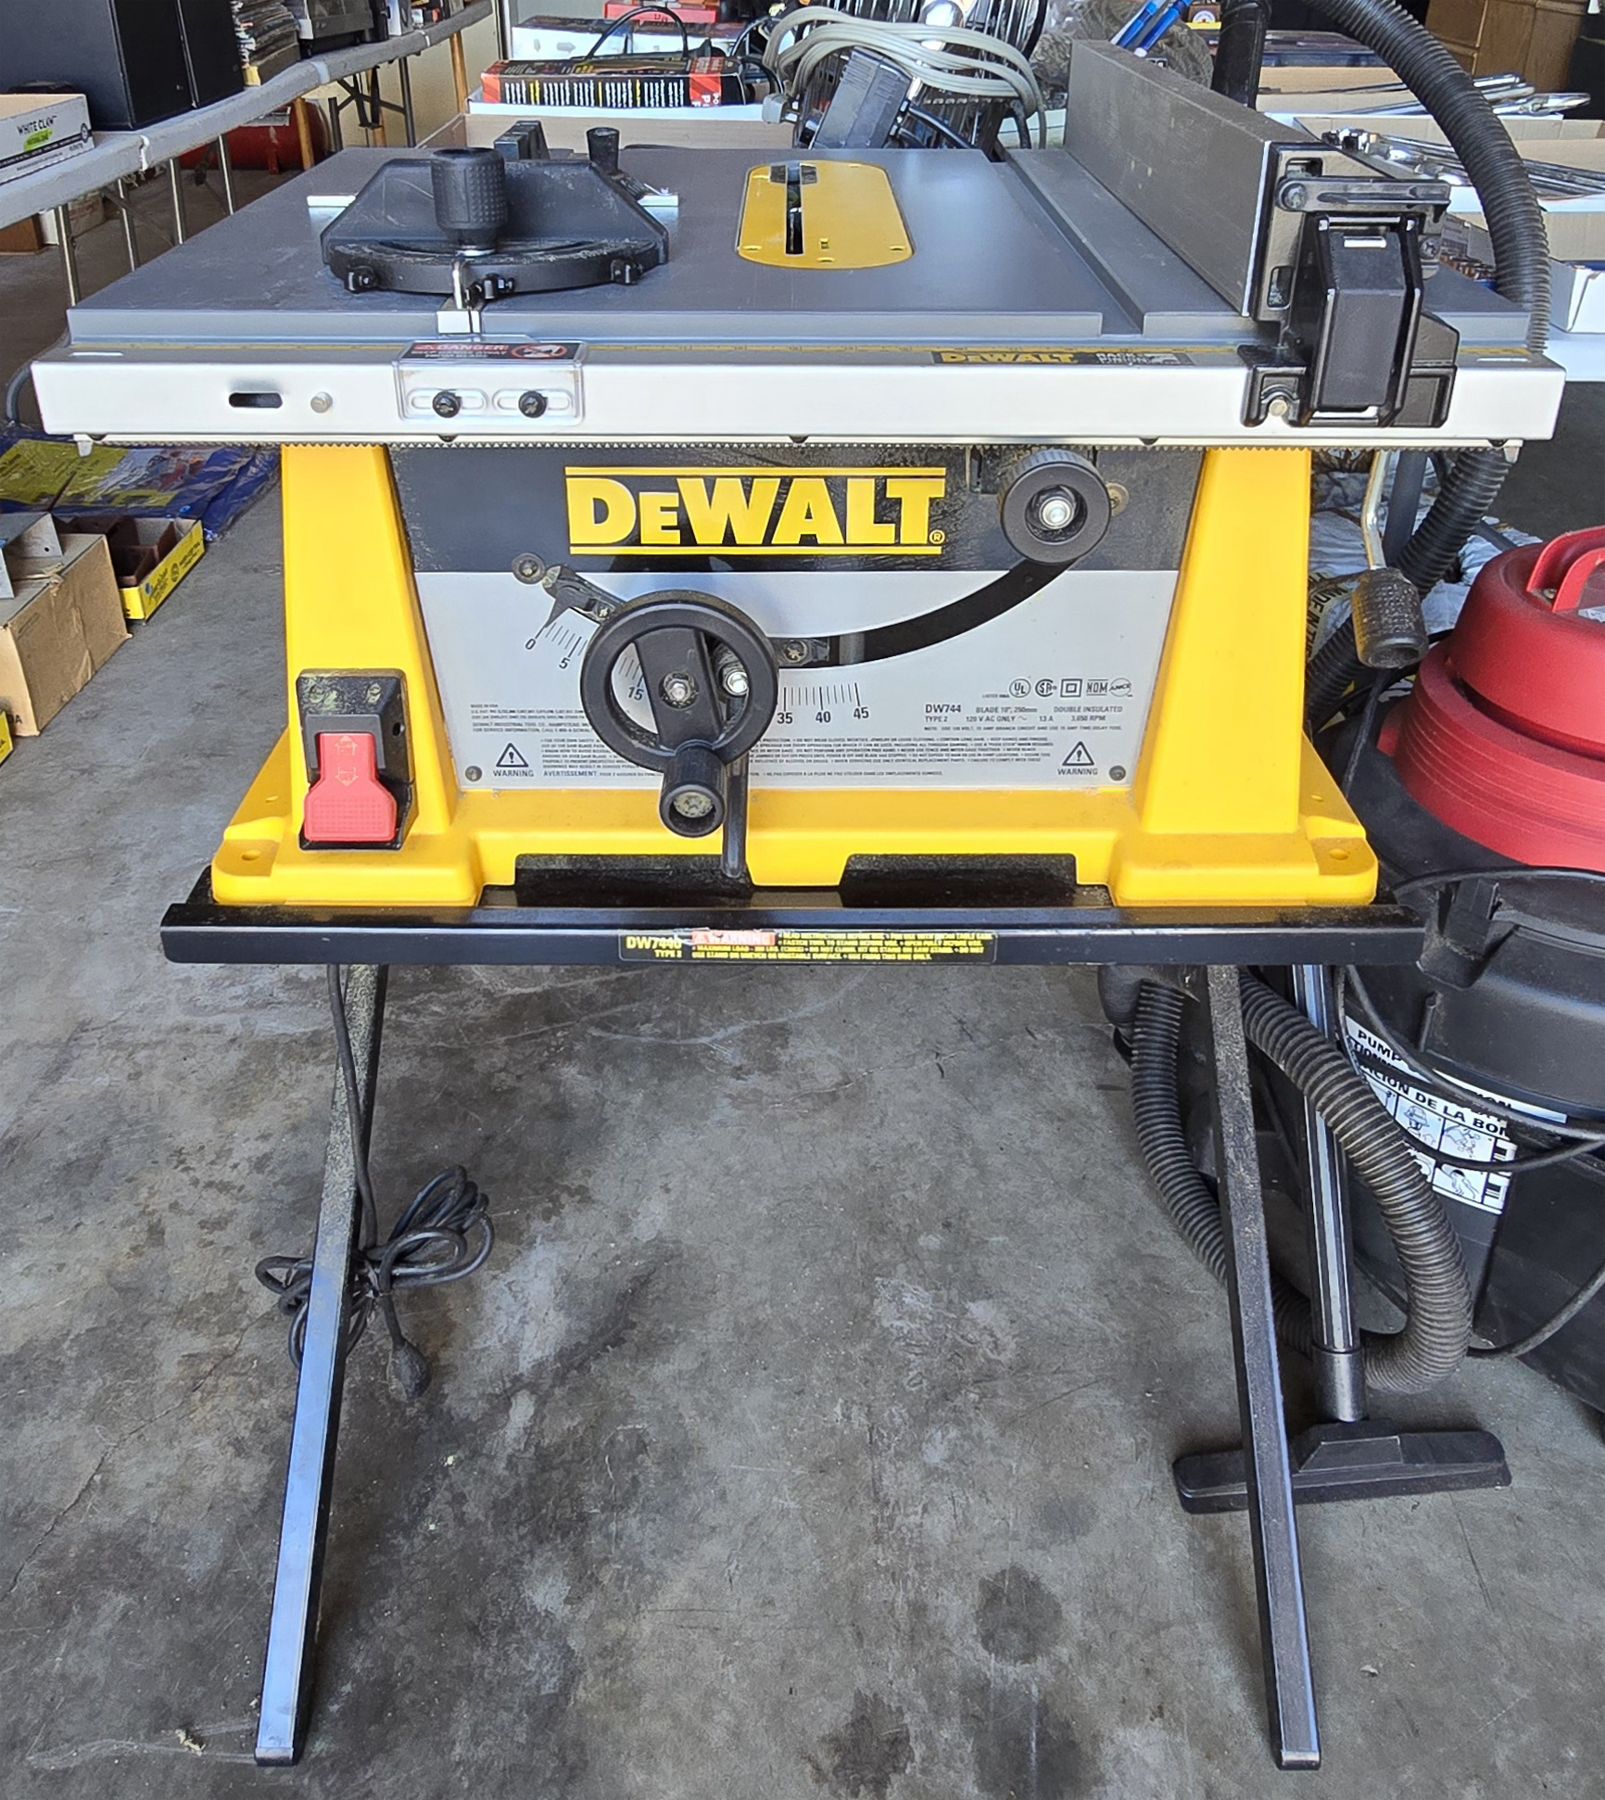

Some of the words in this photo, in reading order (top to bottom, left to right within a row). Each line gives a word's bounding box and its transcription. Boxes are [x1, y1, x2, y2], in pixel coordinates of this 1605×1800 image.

[524, 638, 536, 650] 0
[559, 657, 570, 669] 5
[628, 686, 644, 701] 15
[853, 707, 870, 720] 45
[925, 704, 961, 713] DW744
[777, 712, 794, 725] 35
[815, 712, 832, 724] 40
[1057, 768, 1098, 776] WARNING
[1415, 1092, 1438, 1110] DE
[1443, 1105, 1466, 1122] LA
